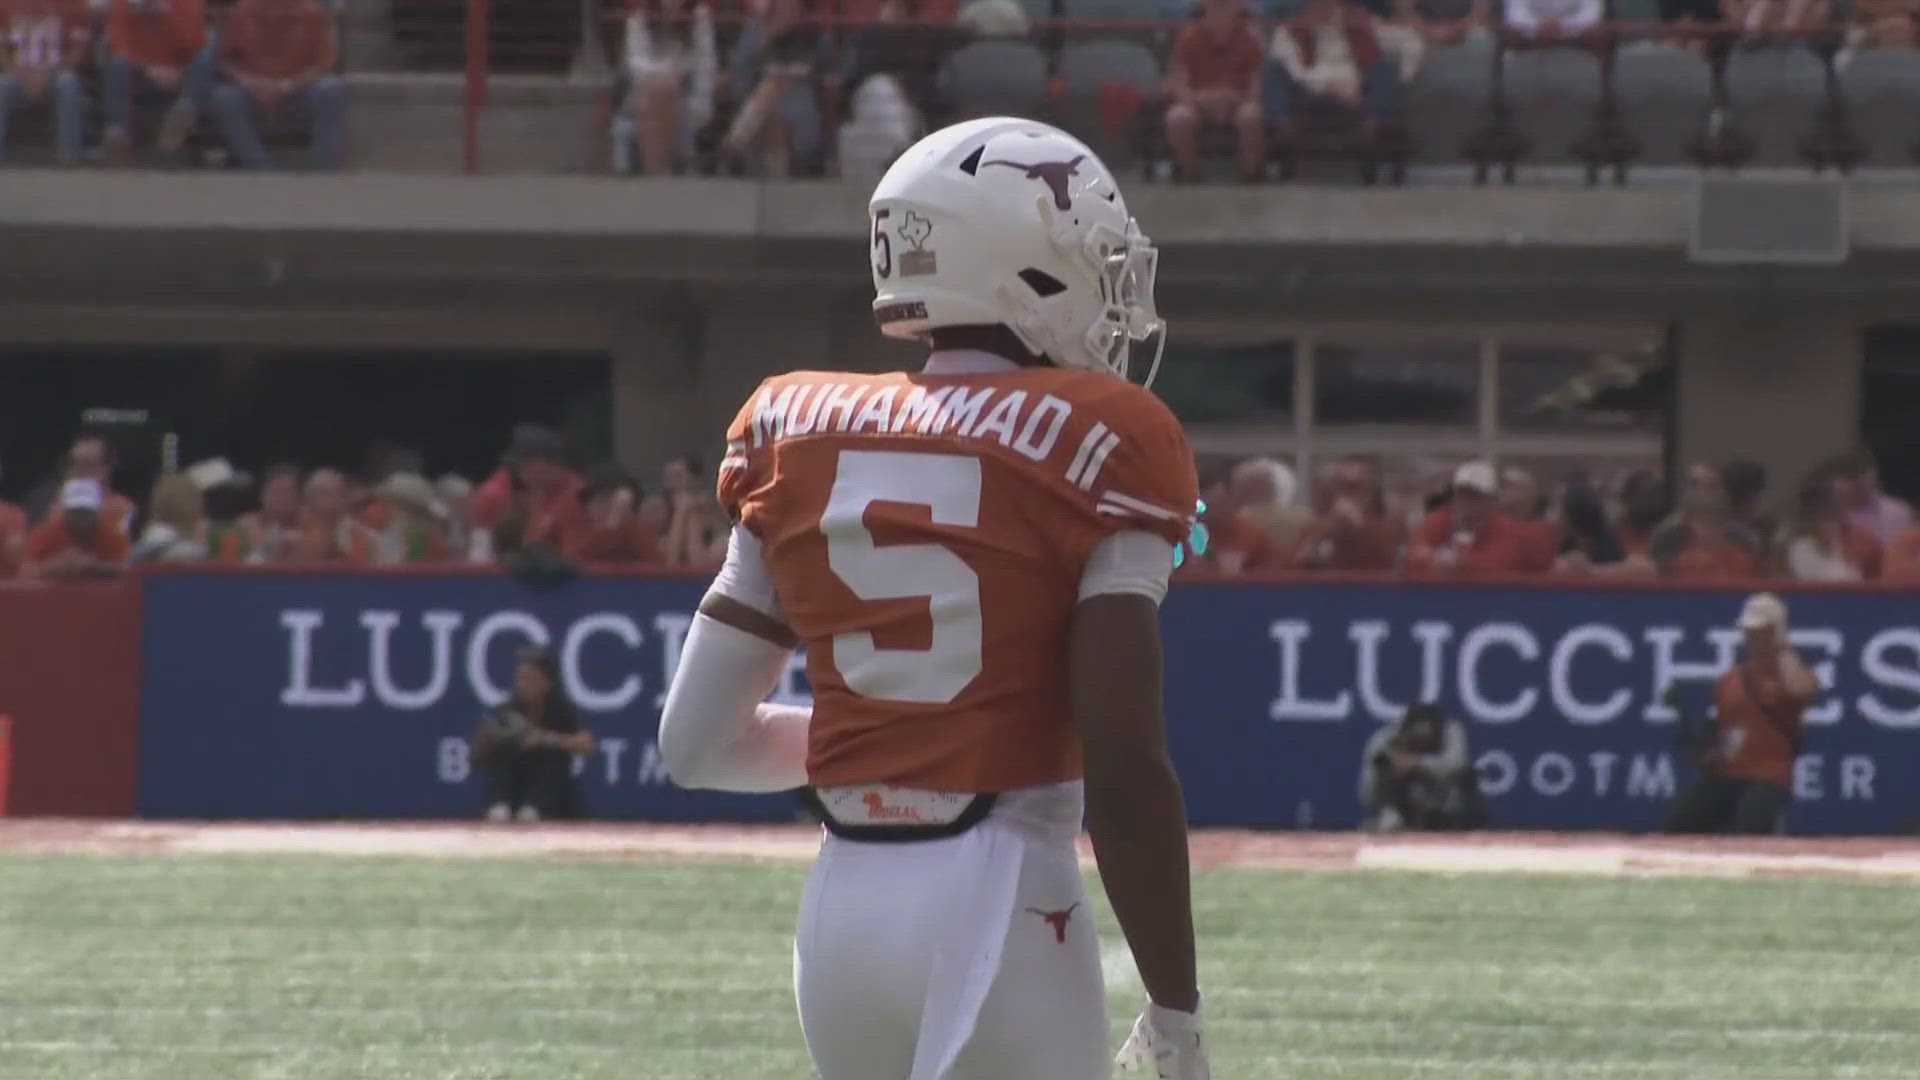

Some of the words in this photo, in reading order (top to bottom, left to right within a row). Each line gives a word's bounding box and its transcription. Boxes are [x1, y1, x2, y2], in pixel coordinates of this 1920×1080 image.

[875, 208, 891, 280] 5
[752, 383, 1072, 462] MUHAMMAD
[1064, 421, 1121, 491] II
[820, 449, 982, 704] 5
